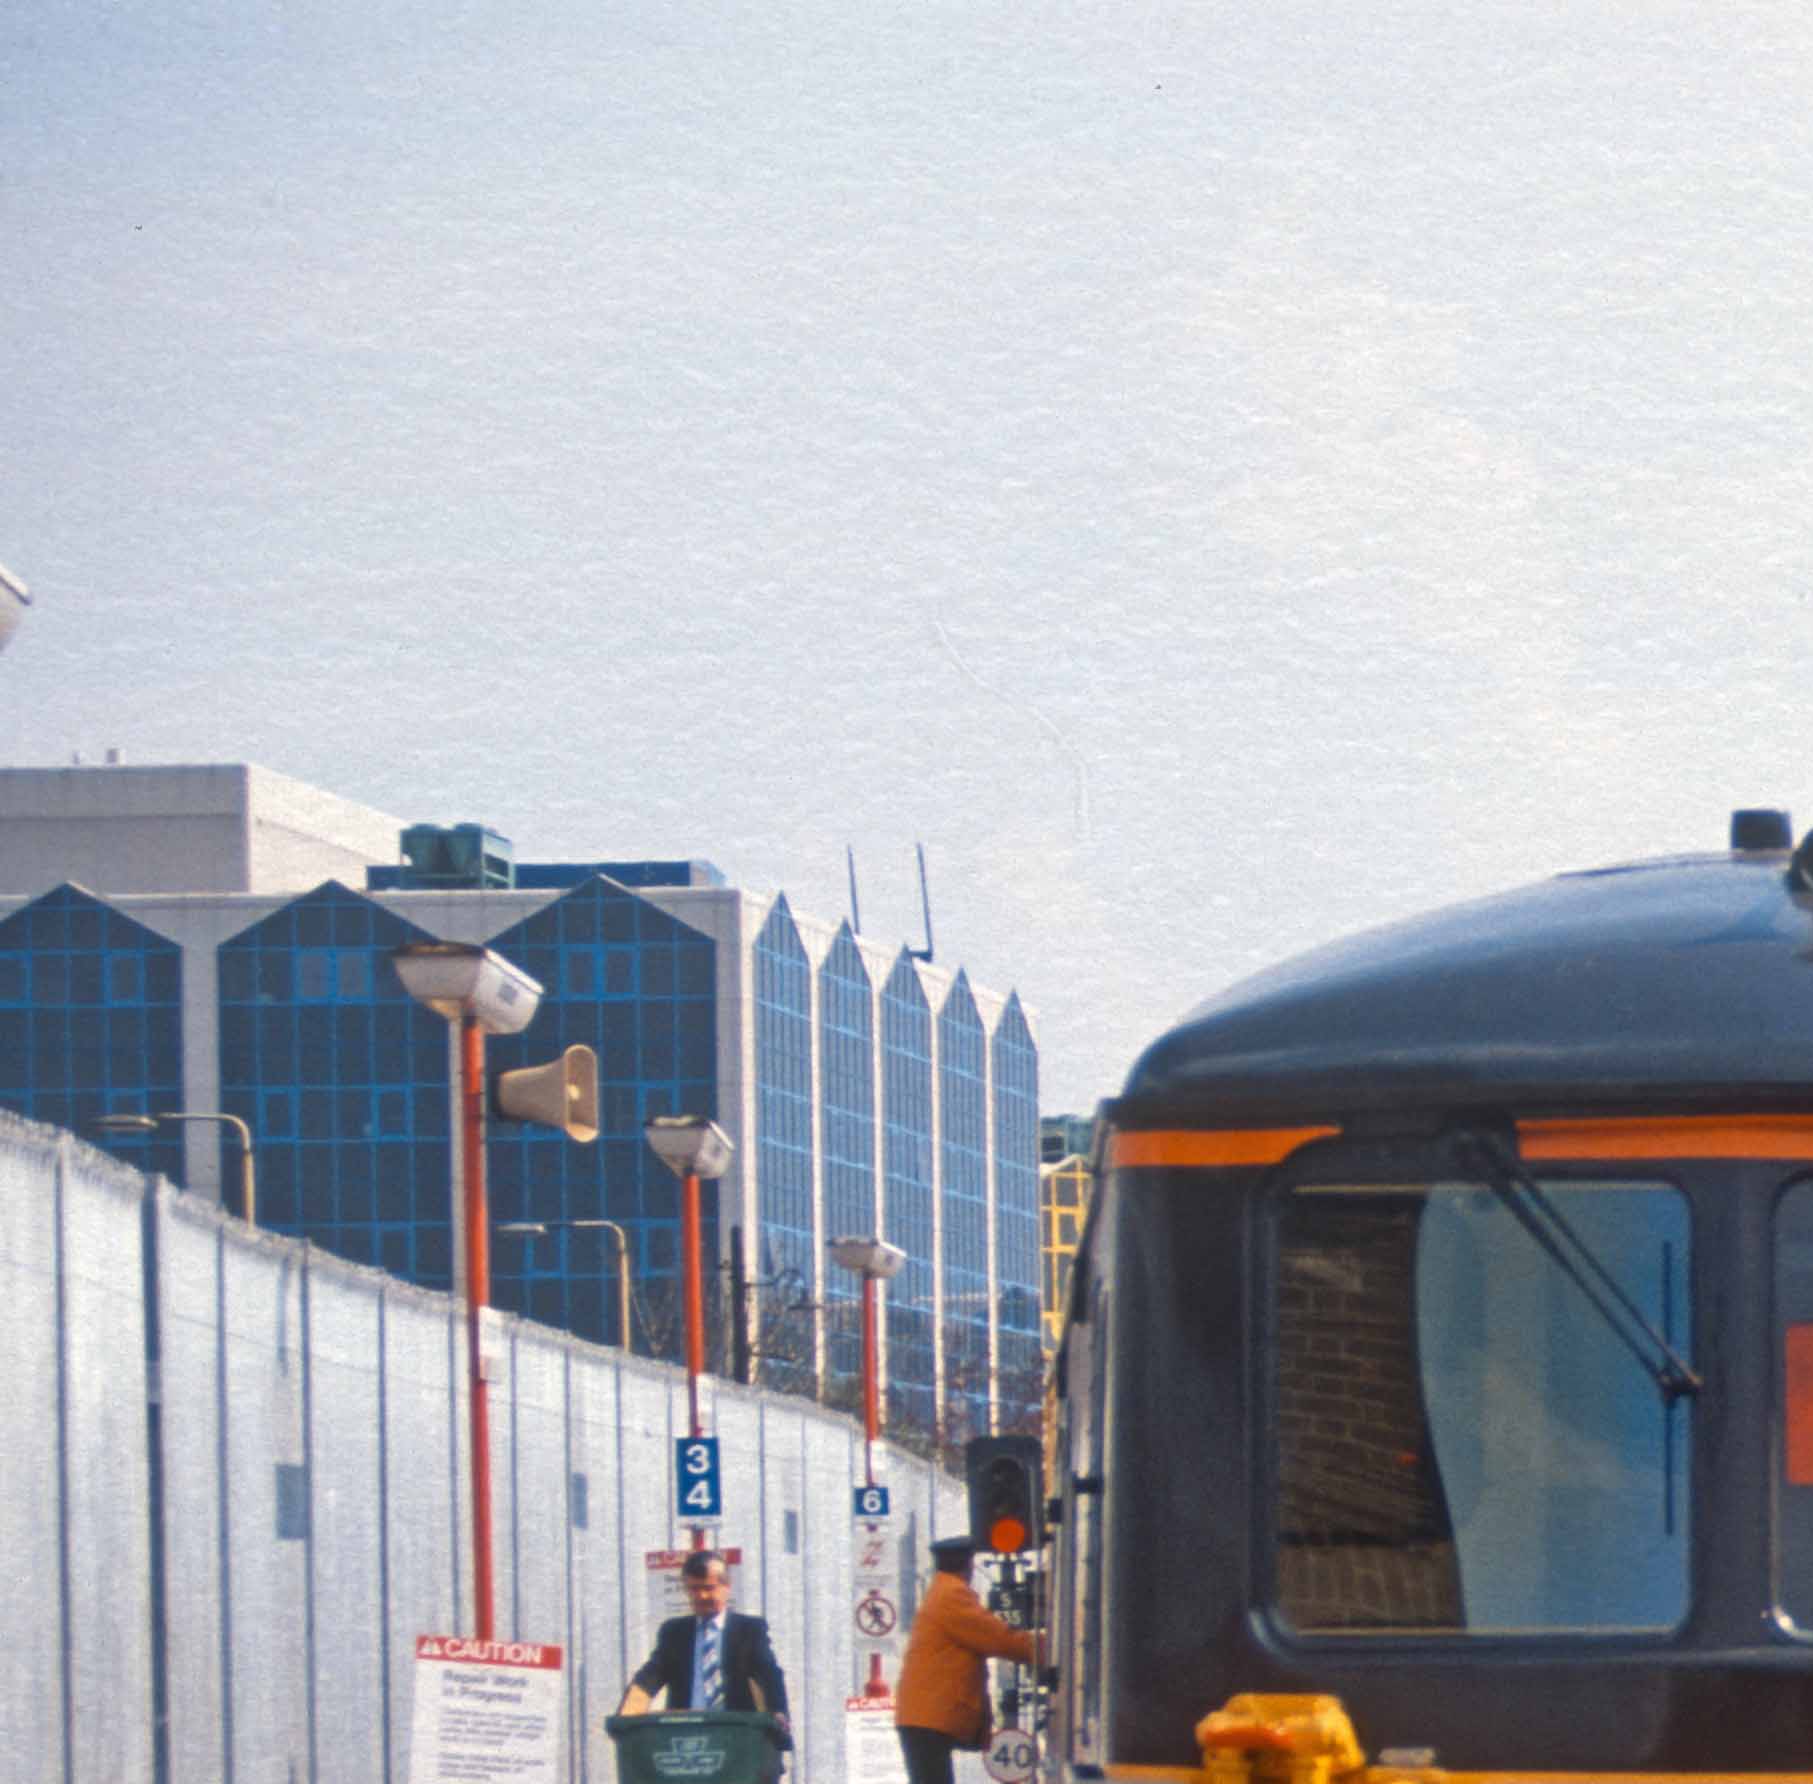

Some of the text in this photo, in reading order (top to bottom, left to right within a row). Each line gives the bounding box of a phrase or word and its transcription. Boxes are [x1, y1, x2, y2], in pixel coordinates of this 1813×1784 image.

[685, 1443, 711, 1474] 3
[685, 1479, 713, 1510] 4
[863, 1489, 881, 1512] 6
[444, 1639, 542, 1665] CAUTION
[993, 1744, 1032, 1769] 40
